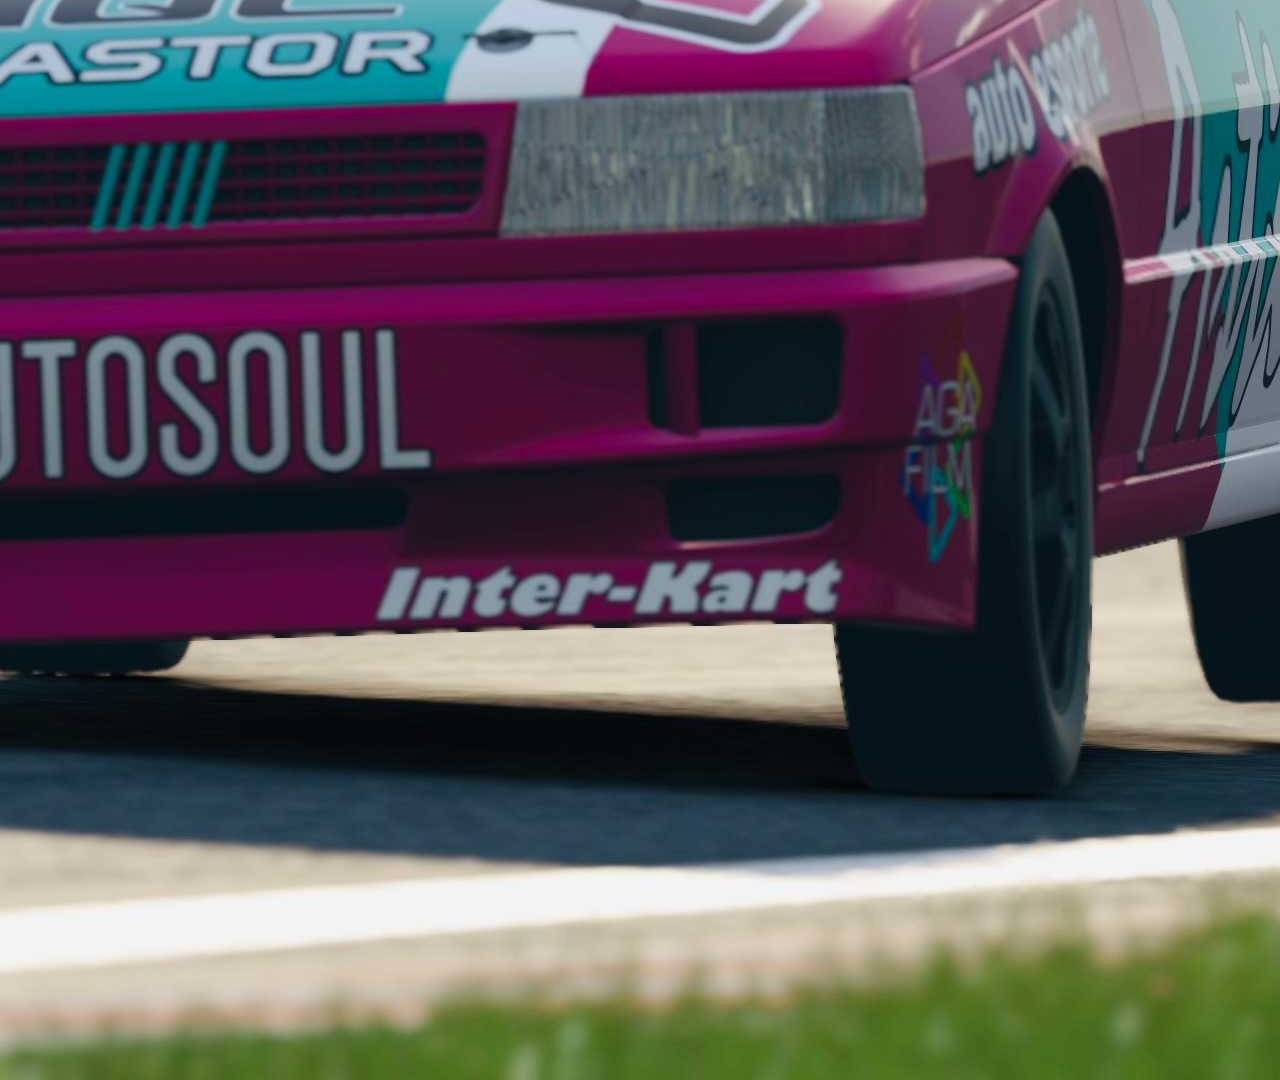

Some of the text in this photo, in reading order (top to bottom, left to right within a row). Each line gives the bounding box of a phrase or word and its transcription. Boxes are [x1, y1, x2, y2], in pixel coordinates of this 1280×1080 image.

[965, 54, 1037, 176] auto
[913, 379, 977, 437] AGA
[904, 437, 974, 495] FILM
[375, 560, 844, 621] Inter-Kart
